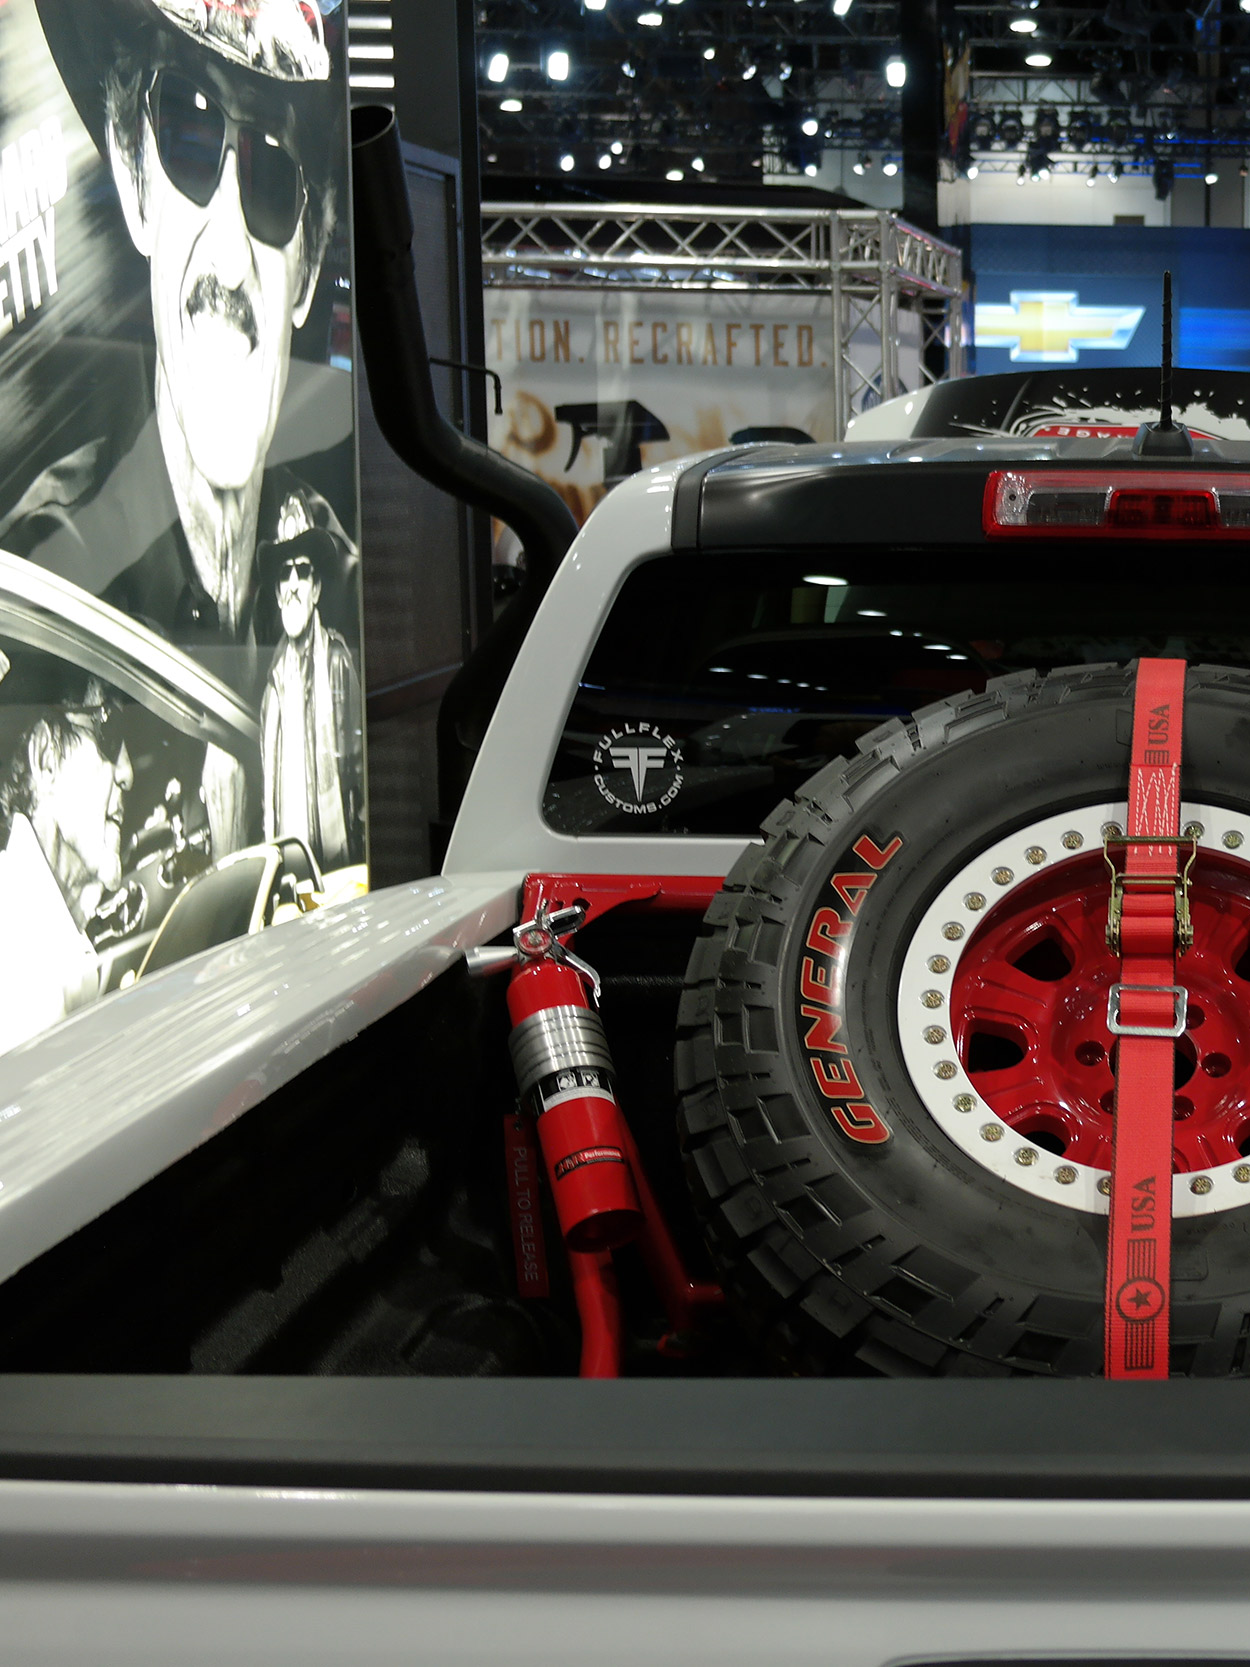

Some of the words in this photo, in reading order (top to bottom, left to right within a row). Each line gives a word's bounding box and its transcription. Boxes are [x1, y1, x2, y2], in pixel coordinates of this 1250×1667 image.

[604, 322, 828, 369] RECRAFTED.
[592, 721, 685, 764] FULLFLEX
[1148, 703, 1171, 746] USA
[800, 834, 904, 1145] GENERAL
[513, 1146, 529, 1187] PULL
[517, 1187, 532, 1211] TO
[1130, 1175, 1157, 1234] USA
[519, 1212, 539, 1283] RELEASE
